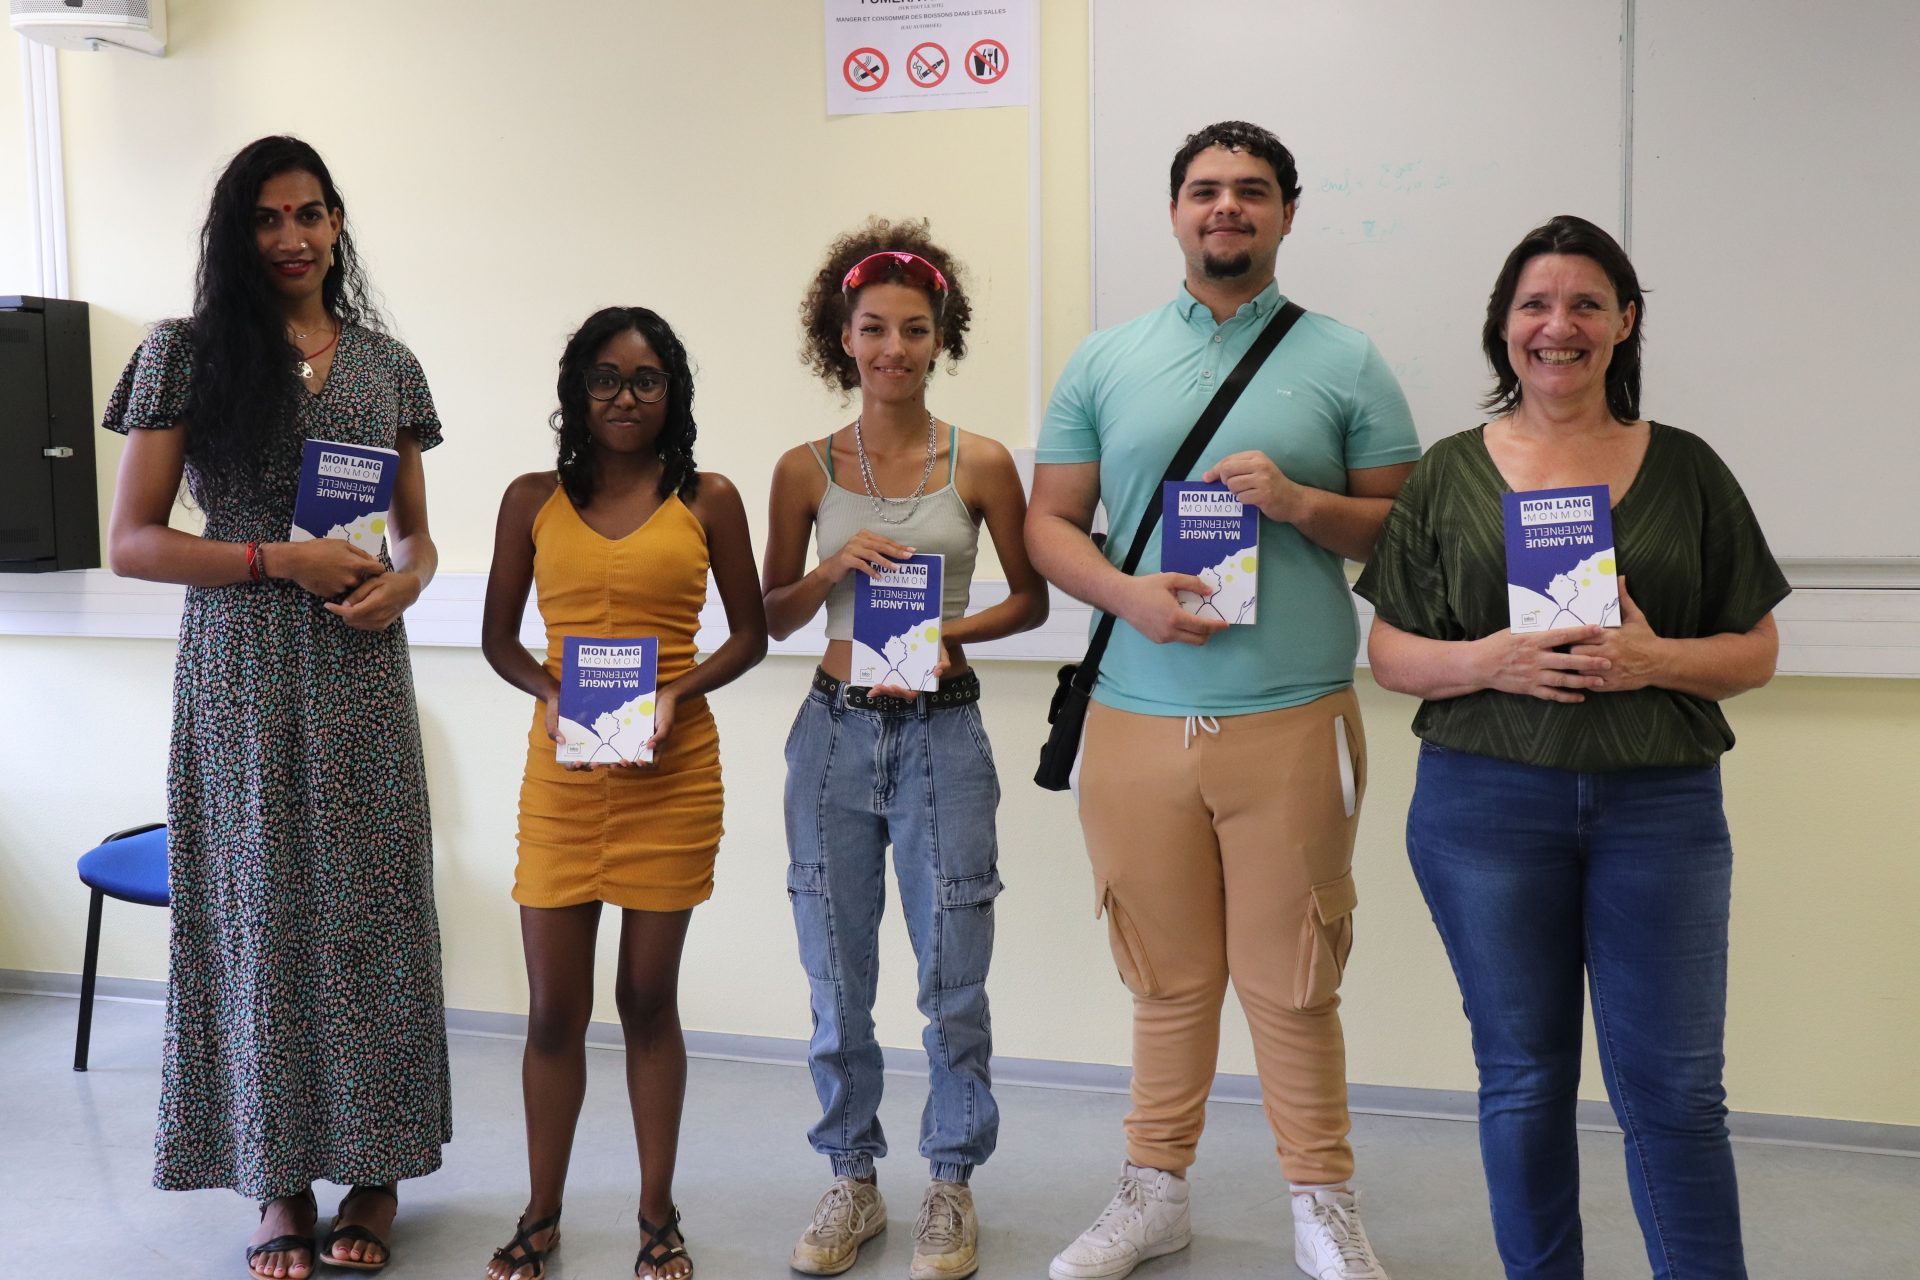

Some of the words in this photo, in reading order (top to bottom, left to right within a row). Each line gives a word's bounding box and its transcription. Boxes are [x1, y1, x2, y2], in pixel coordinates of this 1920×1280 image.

[871, 14, 910, 22] CONSOMMER
[322, 454, 348, 466] MON
[350, 458, 381, 471] LANG
[318, 478, 376, 494] MATERNELLE
[316, 487, 357, 501] LANGUE
[359, 493, 375, 504] MA
[1181, 493, 1208, 503] MON
[1523, 502, 1553, 512] MON
[1556, 498, 1591, 509] LANG
[1180, 519, 1241, 529] MATERNELLE
[1180, 529, 1222, 540] LANGUE
[1224, 530, 1241, 540] MA
[1525, 524, 1593, 538] MATERNELLE
[1525, 536, 1574, 549] LANGUE
[1574, 534, 1594, 545] MA
[899, 565, 927, 576] LANG
[871, 588, 925, 601] MATERNELLE
[870, 599, 909, 610] LANGUE
[909, 601, 925, 611] MA
[580, 647, 607, 657] MON
[610, 647, 641, 657] LANG
[579, 669, 639, 679] MATERNELLE
[579, 678, 621, 689] LANGUE
[623, 679, 639, 688] MA
